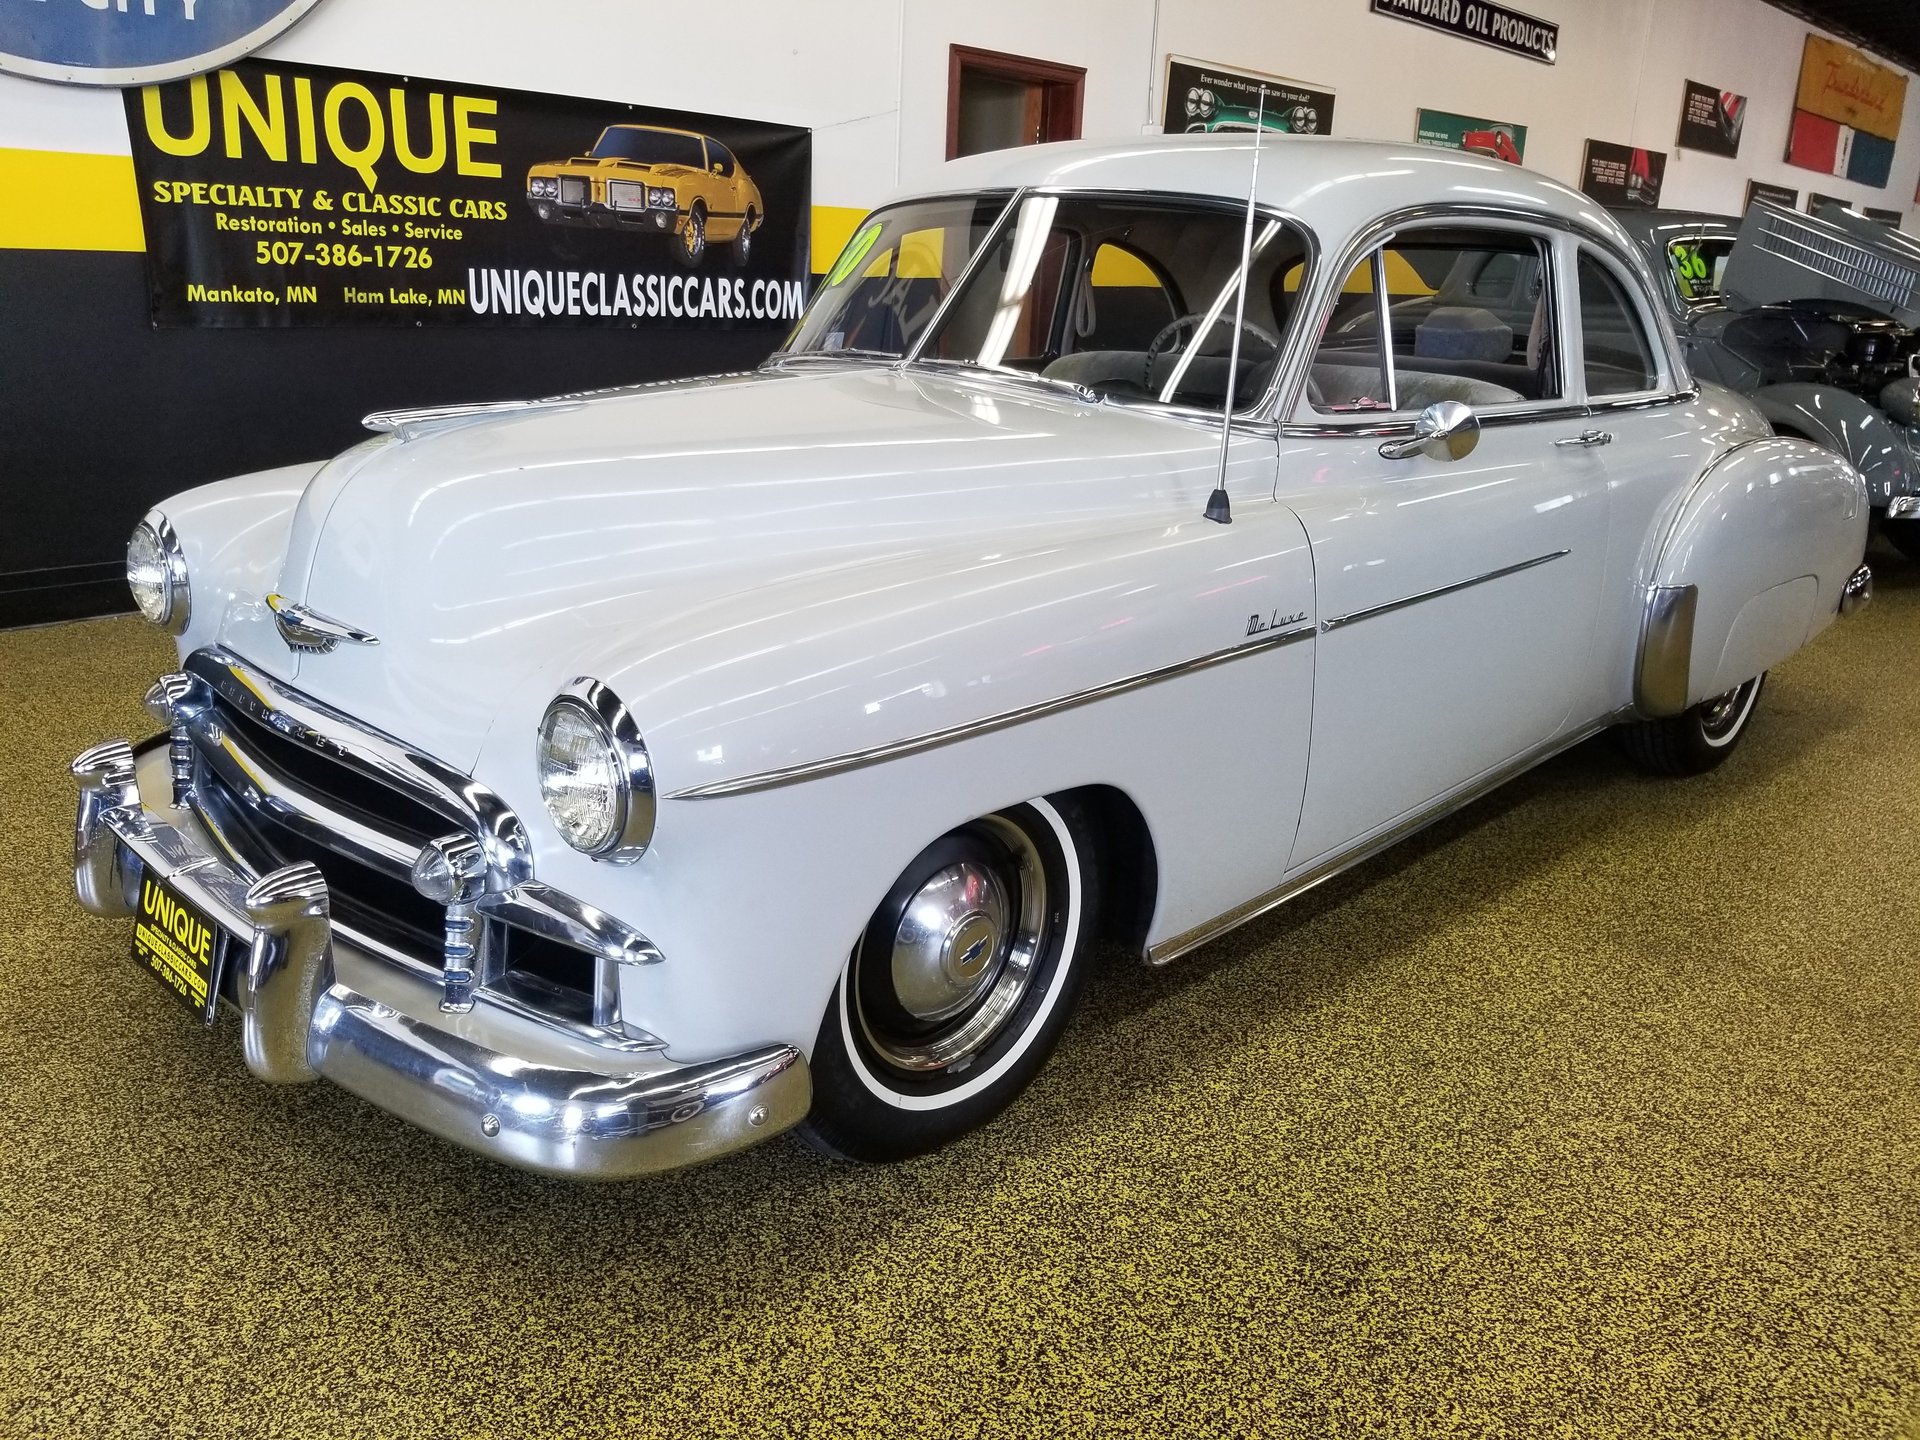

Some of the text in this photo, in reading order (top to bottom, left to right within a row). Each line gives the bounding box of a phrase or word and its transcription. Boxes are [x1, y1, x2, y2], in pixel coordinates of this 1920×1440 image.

[1466, 4, 1488, 35] OIL
[1492, 12, 1555, 52] PRODUCTS
[142, 70, 503, 192] UNIQUE
[154, 180, 508, 221] SPECIALTY & CLASSIC CARS
[215, 212, 463, 241] Restoration Sales Service
[256, 241, 433, 269] 507-386-1726
[1674, 245, 1707, 279] 36
[187, 284, 466, 306] Mankato, MN Ham Lake, MN
[468, 268, 803, 320] UNIQUECLASSICCARS.COM
[144, 880, 211, 966] UNIQUE
[150, 954, 187, 997] 507-386-1726
